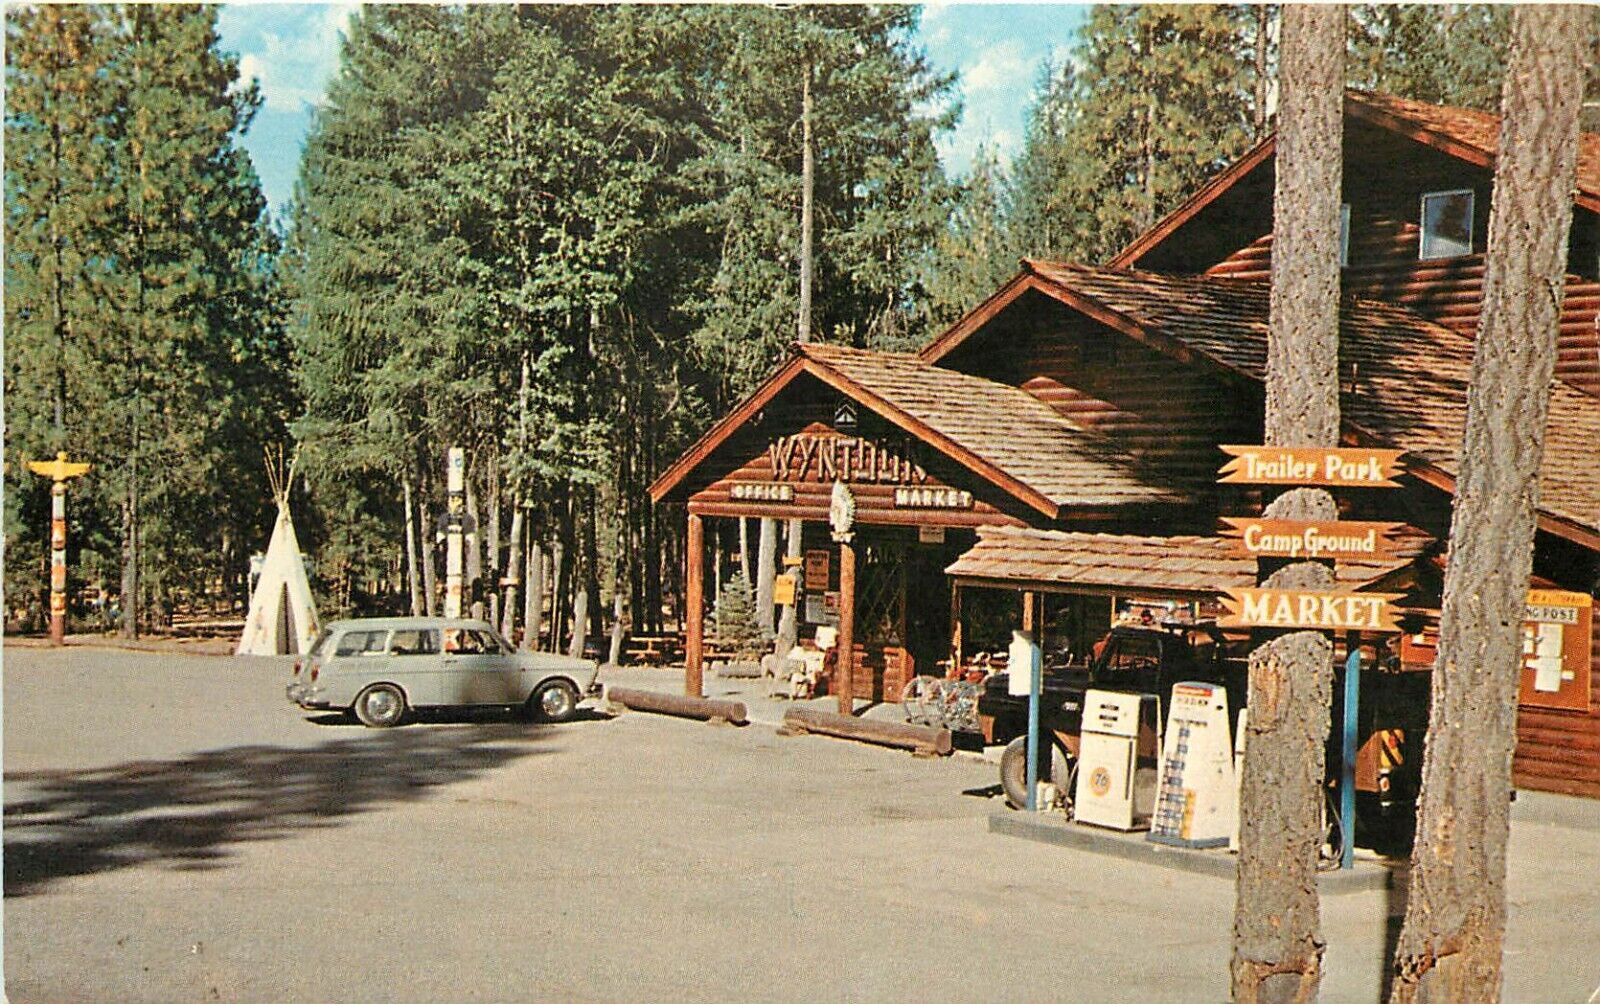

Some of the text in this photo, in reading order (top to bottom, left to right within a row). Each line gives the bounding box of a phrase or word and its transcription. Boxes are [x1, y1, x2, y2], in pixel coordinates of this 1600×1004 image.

[1244, 453, 1383, 481] Trailer Park
[734, 484, 790, 500] OFFICE
[896, 489, 972, 507] MARKET
[1241, 592, 1387, 627] MARKET
